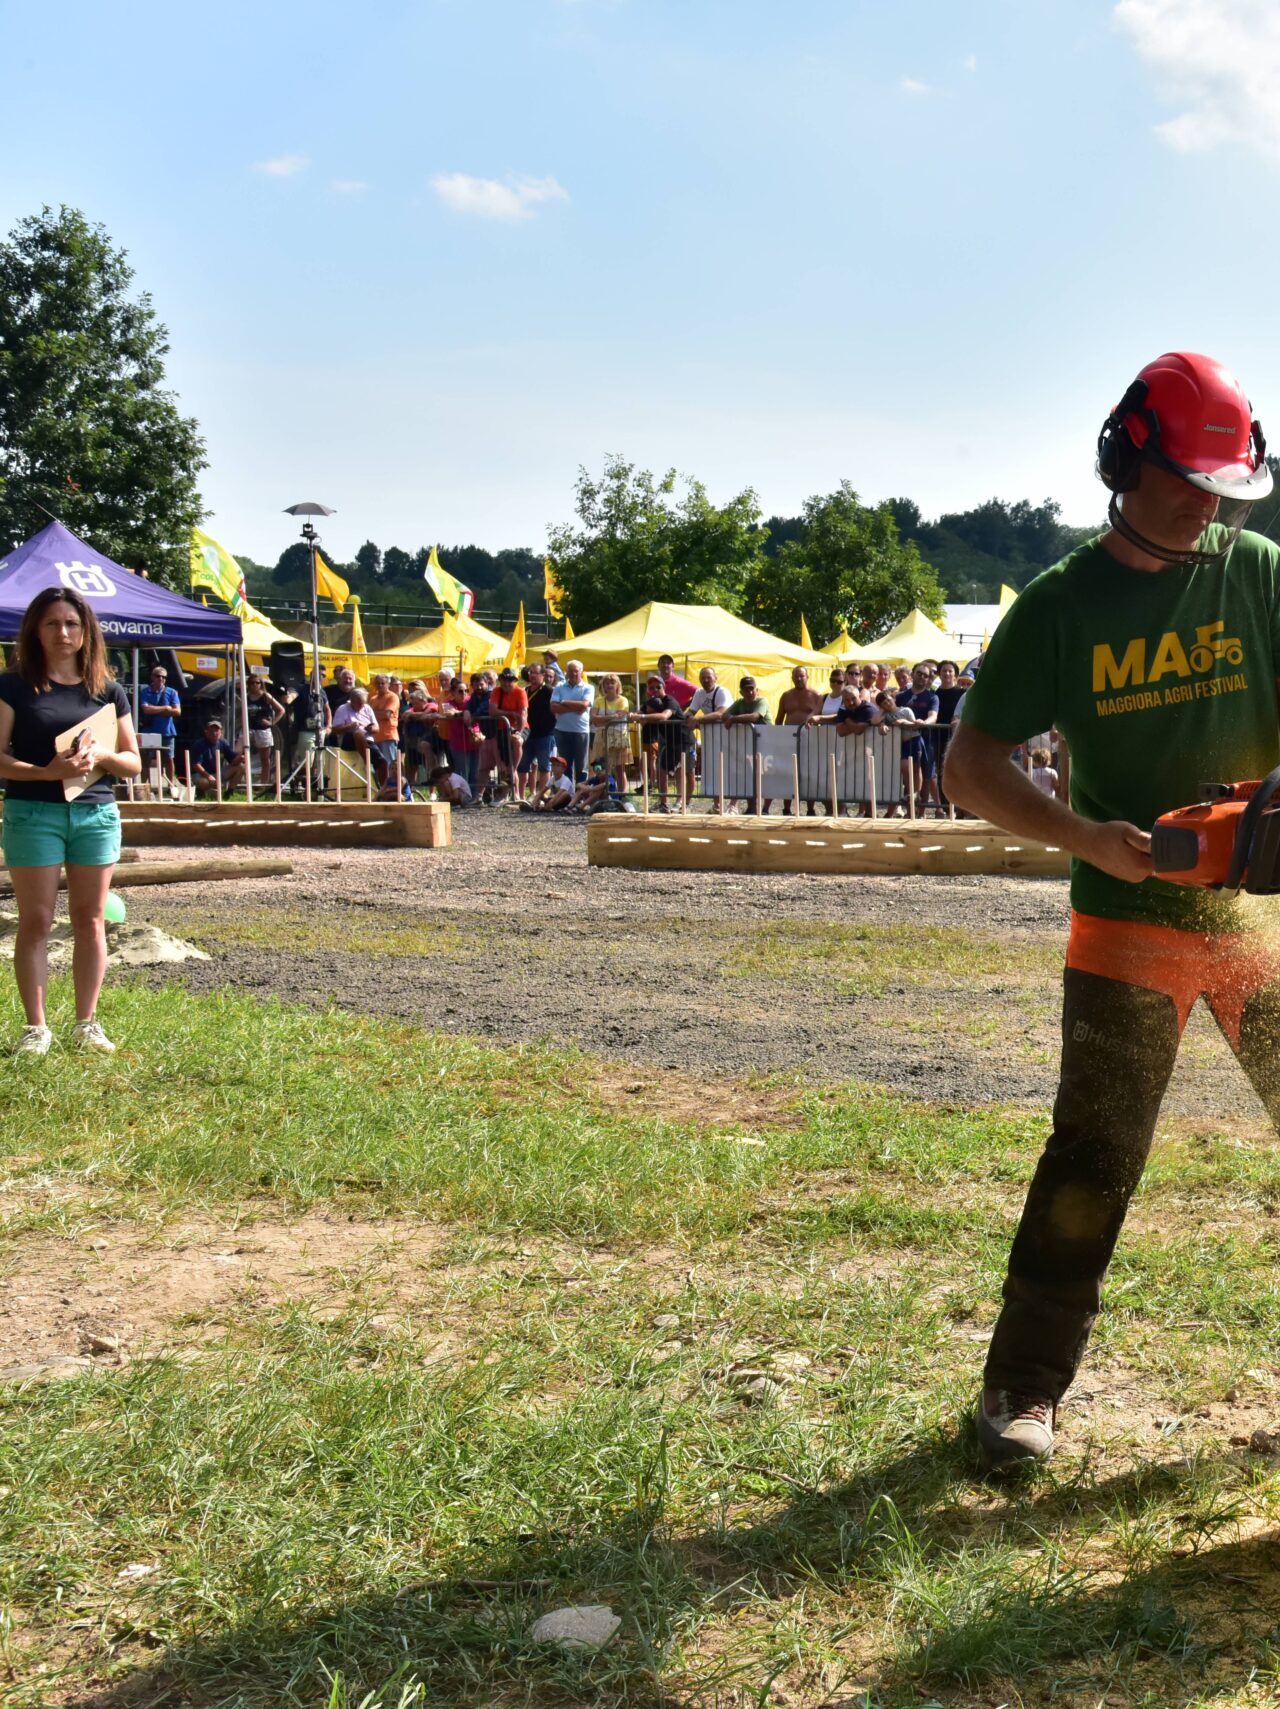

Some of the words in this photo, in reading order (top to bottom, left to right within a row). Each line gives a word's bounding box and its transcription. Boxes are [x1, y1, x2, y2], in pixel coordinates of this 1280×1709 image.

[1203, 423, 1236, 434] Jonsered
[99, 620, 164, 635] sqvarna
[1096, 690, 1162, 717] MAGGIORA
[1164, 684, 1193, 705] AGRI
[1195, 673, 1248, 699] FESTIVAL
